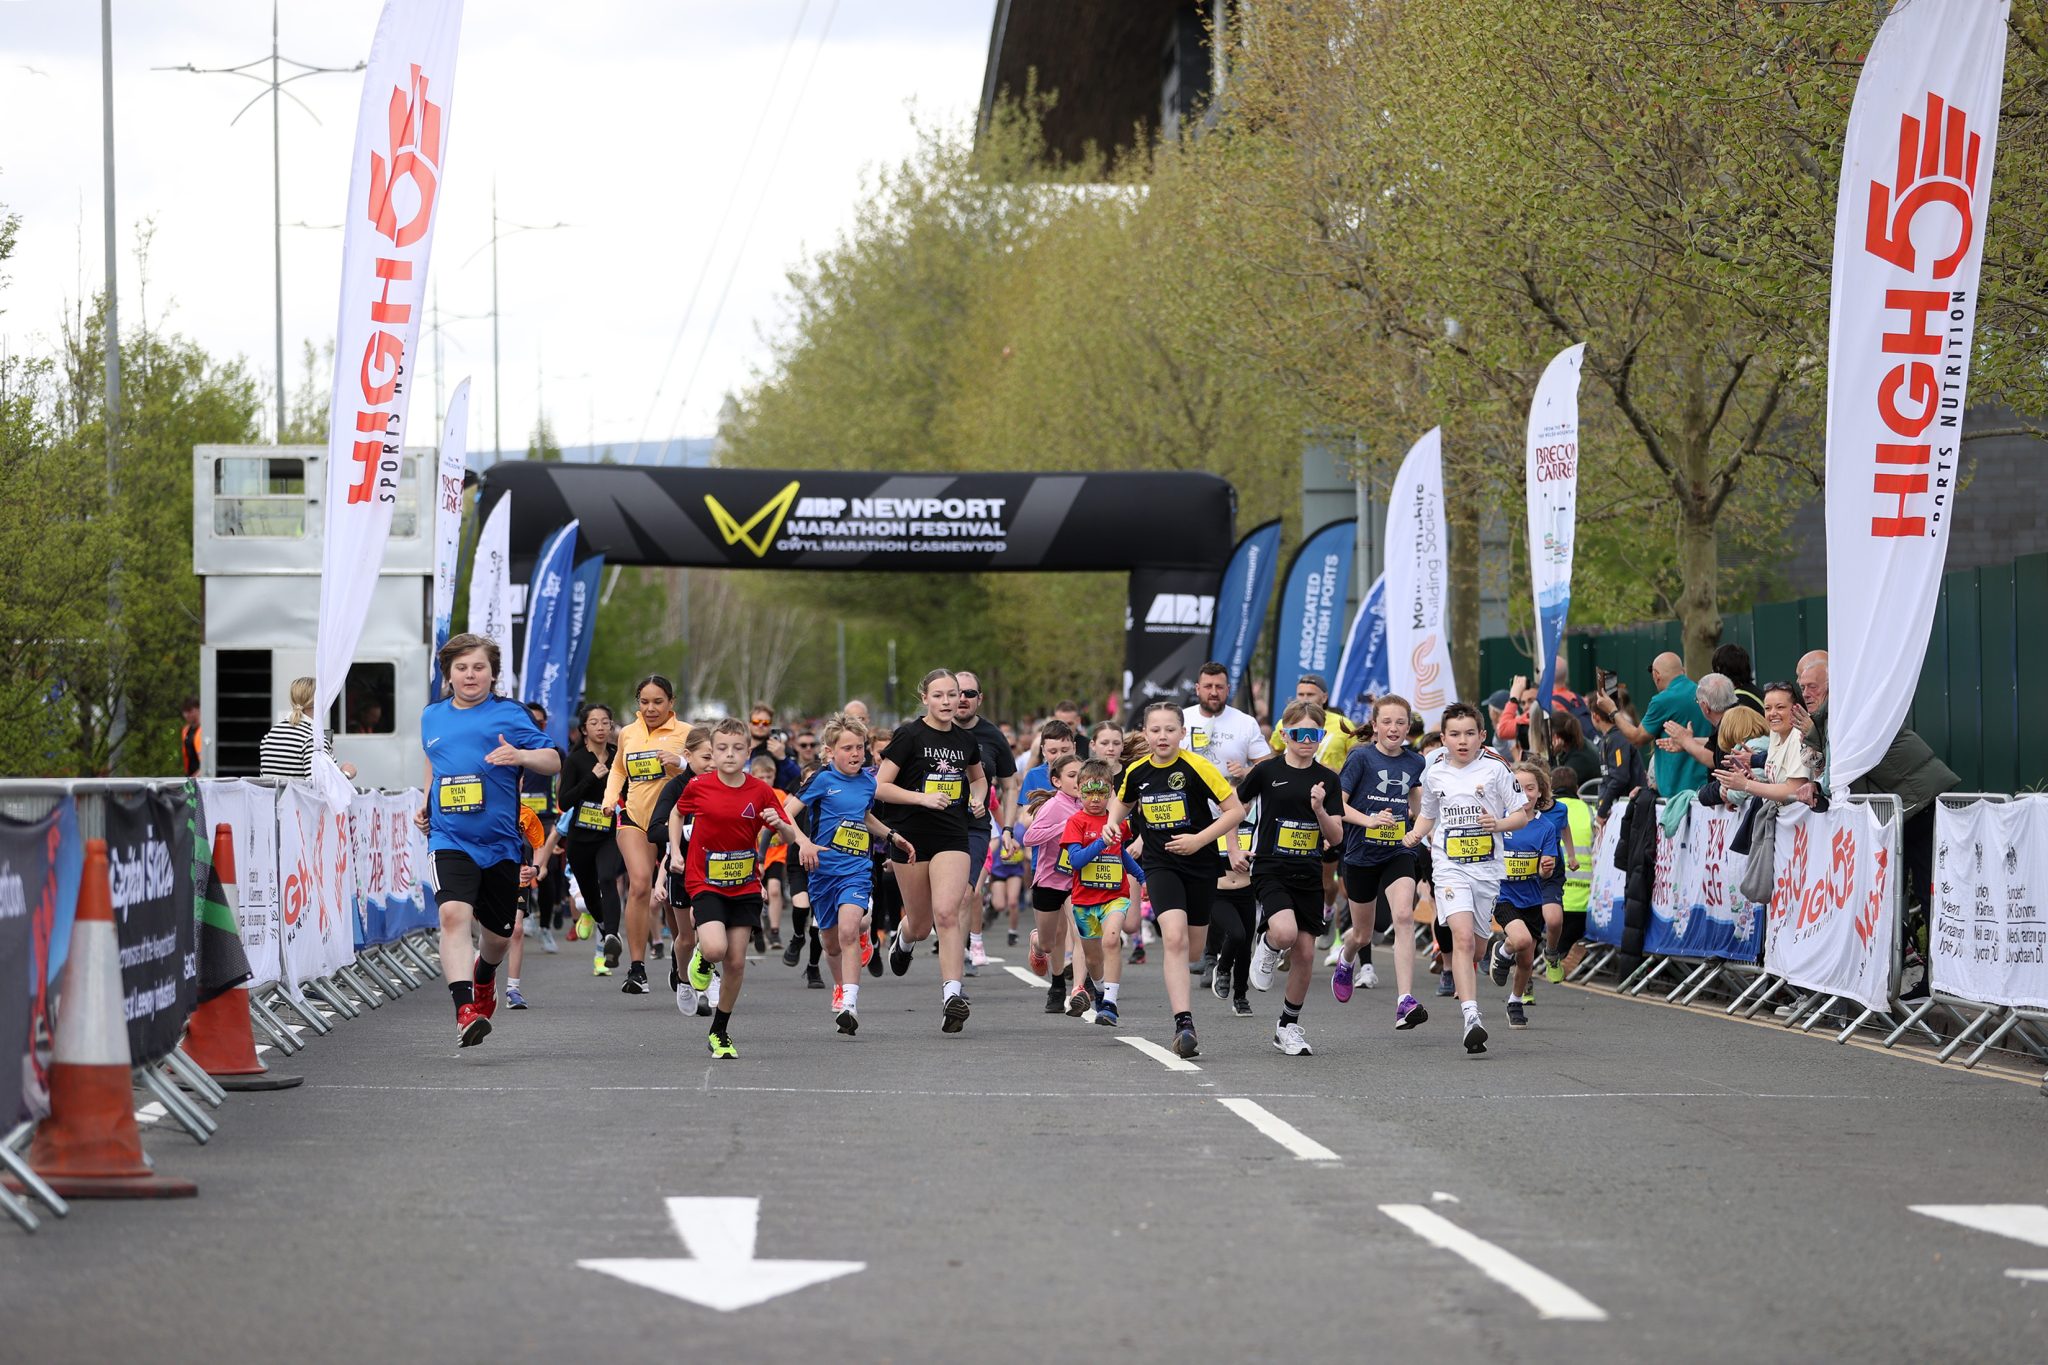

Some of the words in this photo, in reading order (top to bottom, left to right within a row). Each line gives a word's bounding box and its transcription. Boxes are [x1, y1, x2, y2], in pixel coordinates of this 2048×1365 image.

[1865, 91, 1981, 538] HIGH5
[1940, 291, 1966, 427] NUTRITION
[851, 498, 1006, 519] NEWPORT
[787, 520, 905, 537] MARATHON
[909, 521, 1007, 537] FESTIVAL
[822, 540, 905, 552] MARATHON
[909, 540, 1007, 552] CASNEWYDD
[1321, 554, 1339, 606] PORTS
[1300, 572, 1321, 670] ASSOCIATED
[1313, 602, 1334, 671] BRITISH
[923, 747, 965, 762] HAWAII
[450, 787, 466, 795] RYAN
[937, 783, 954, 791] BELLA
[1367, 794, 1389, 802] UNDER
[1150, 804, 1172, 812] GRACIE
[1443, 805, 1481, 817] Emirate
[1291, 831, 1311, 840] ARCHIE
[1379, 831, 1396, 839] 9602
[1460, 839, 1479, 847] MILES
[1461, 847, 1478, 855] 9422
[722, 862, 744, 870] JACOB
[1096, 865, 1111, 873] ERIC
[723, 870, 742, 878] 9406
[1511, 867, 1527, 875] 9603
[1095, 872, 1112, 881] 9456
[1796, 825, 1856, 930] IGH5
